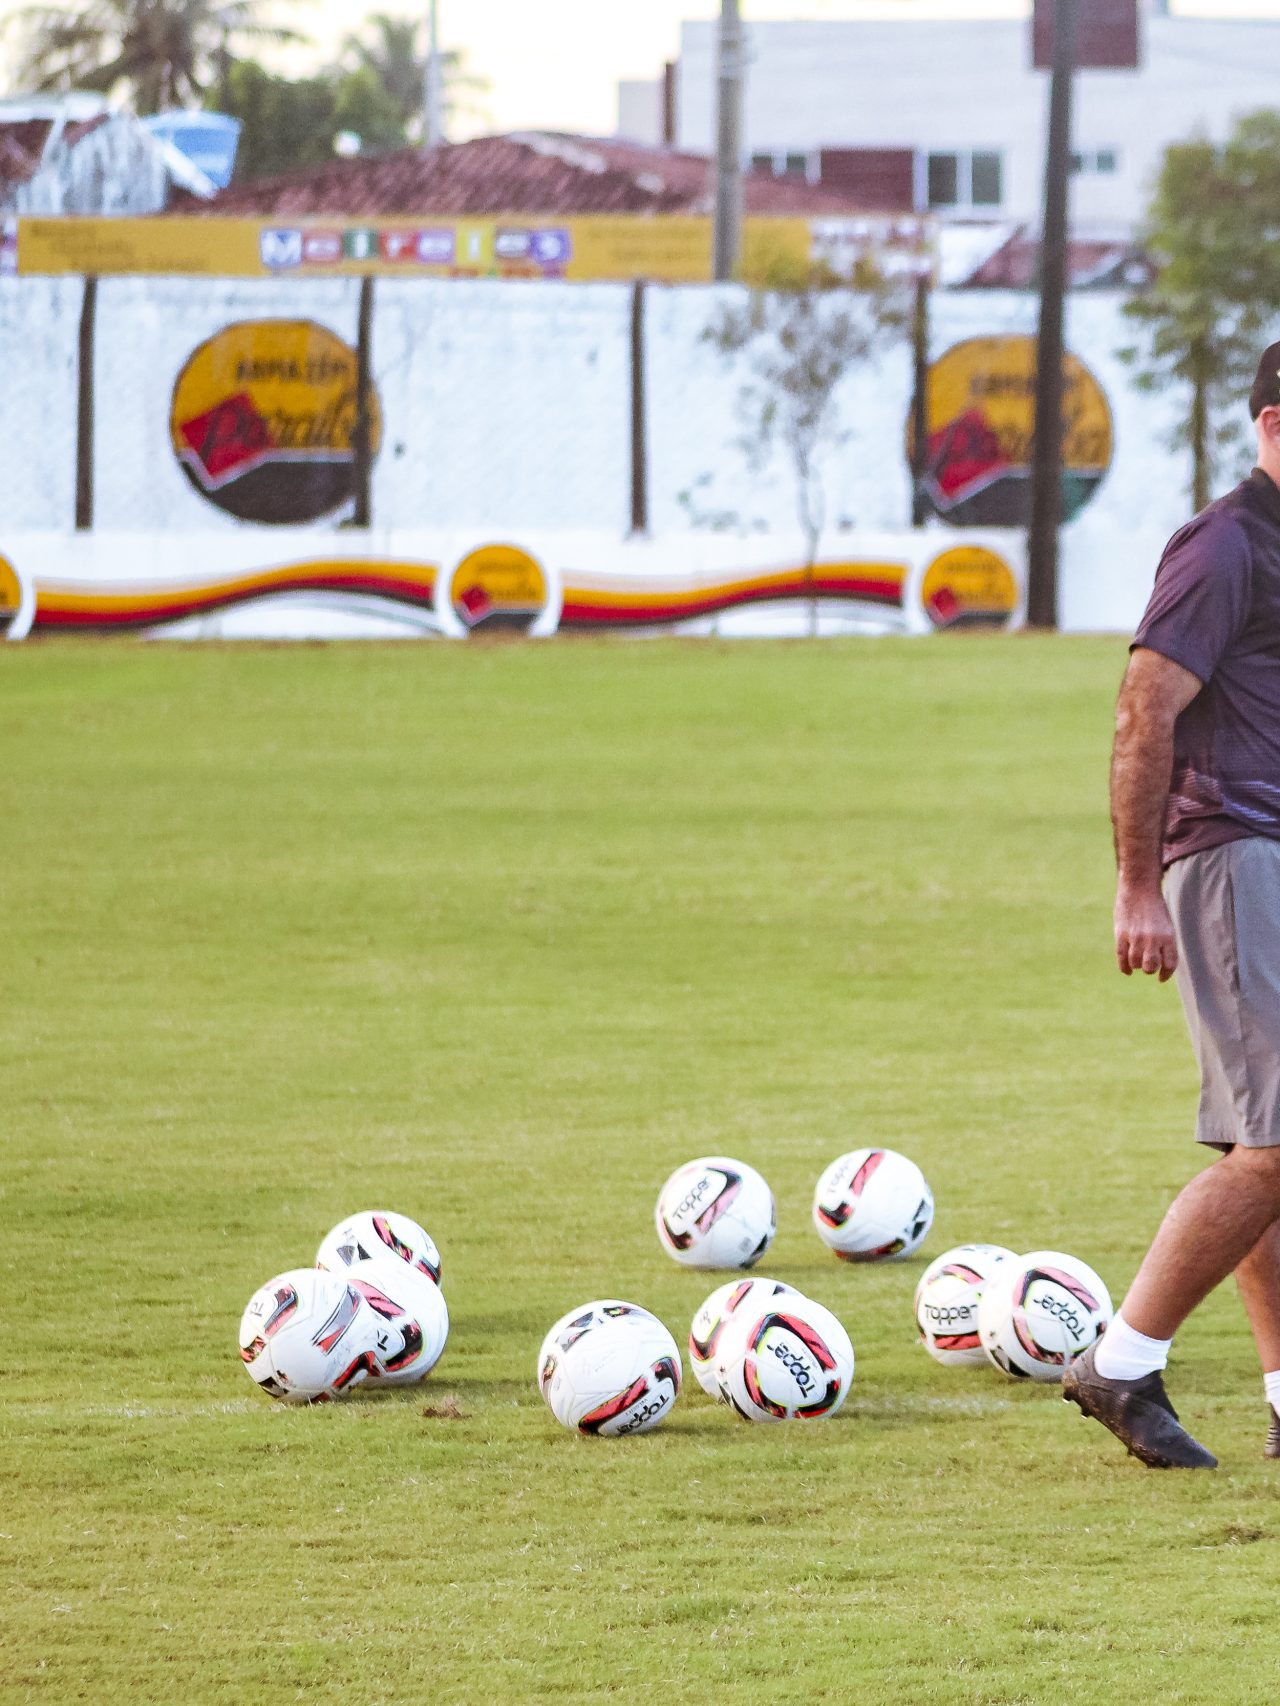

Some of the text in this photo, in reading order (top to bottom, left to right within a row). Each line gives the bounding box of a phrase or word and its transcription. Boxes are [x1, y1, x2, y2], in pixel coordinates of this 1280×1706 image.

[672, 1175, 711, 1220] Topper
[924, 1303, 978, 1326] Topper
[1033, 1293, 1086, 1343] Topper
[766, 1342, 816, 1399] Topper
